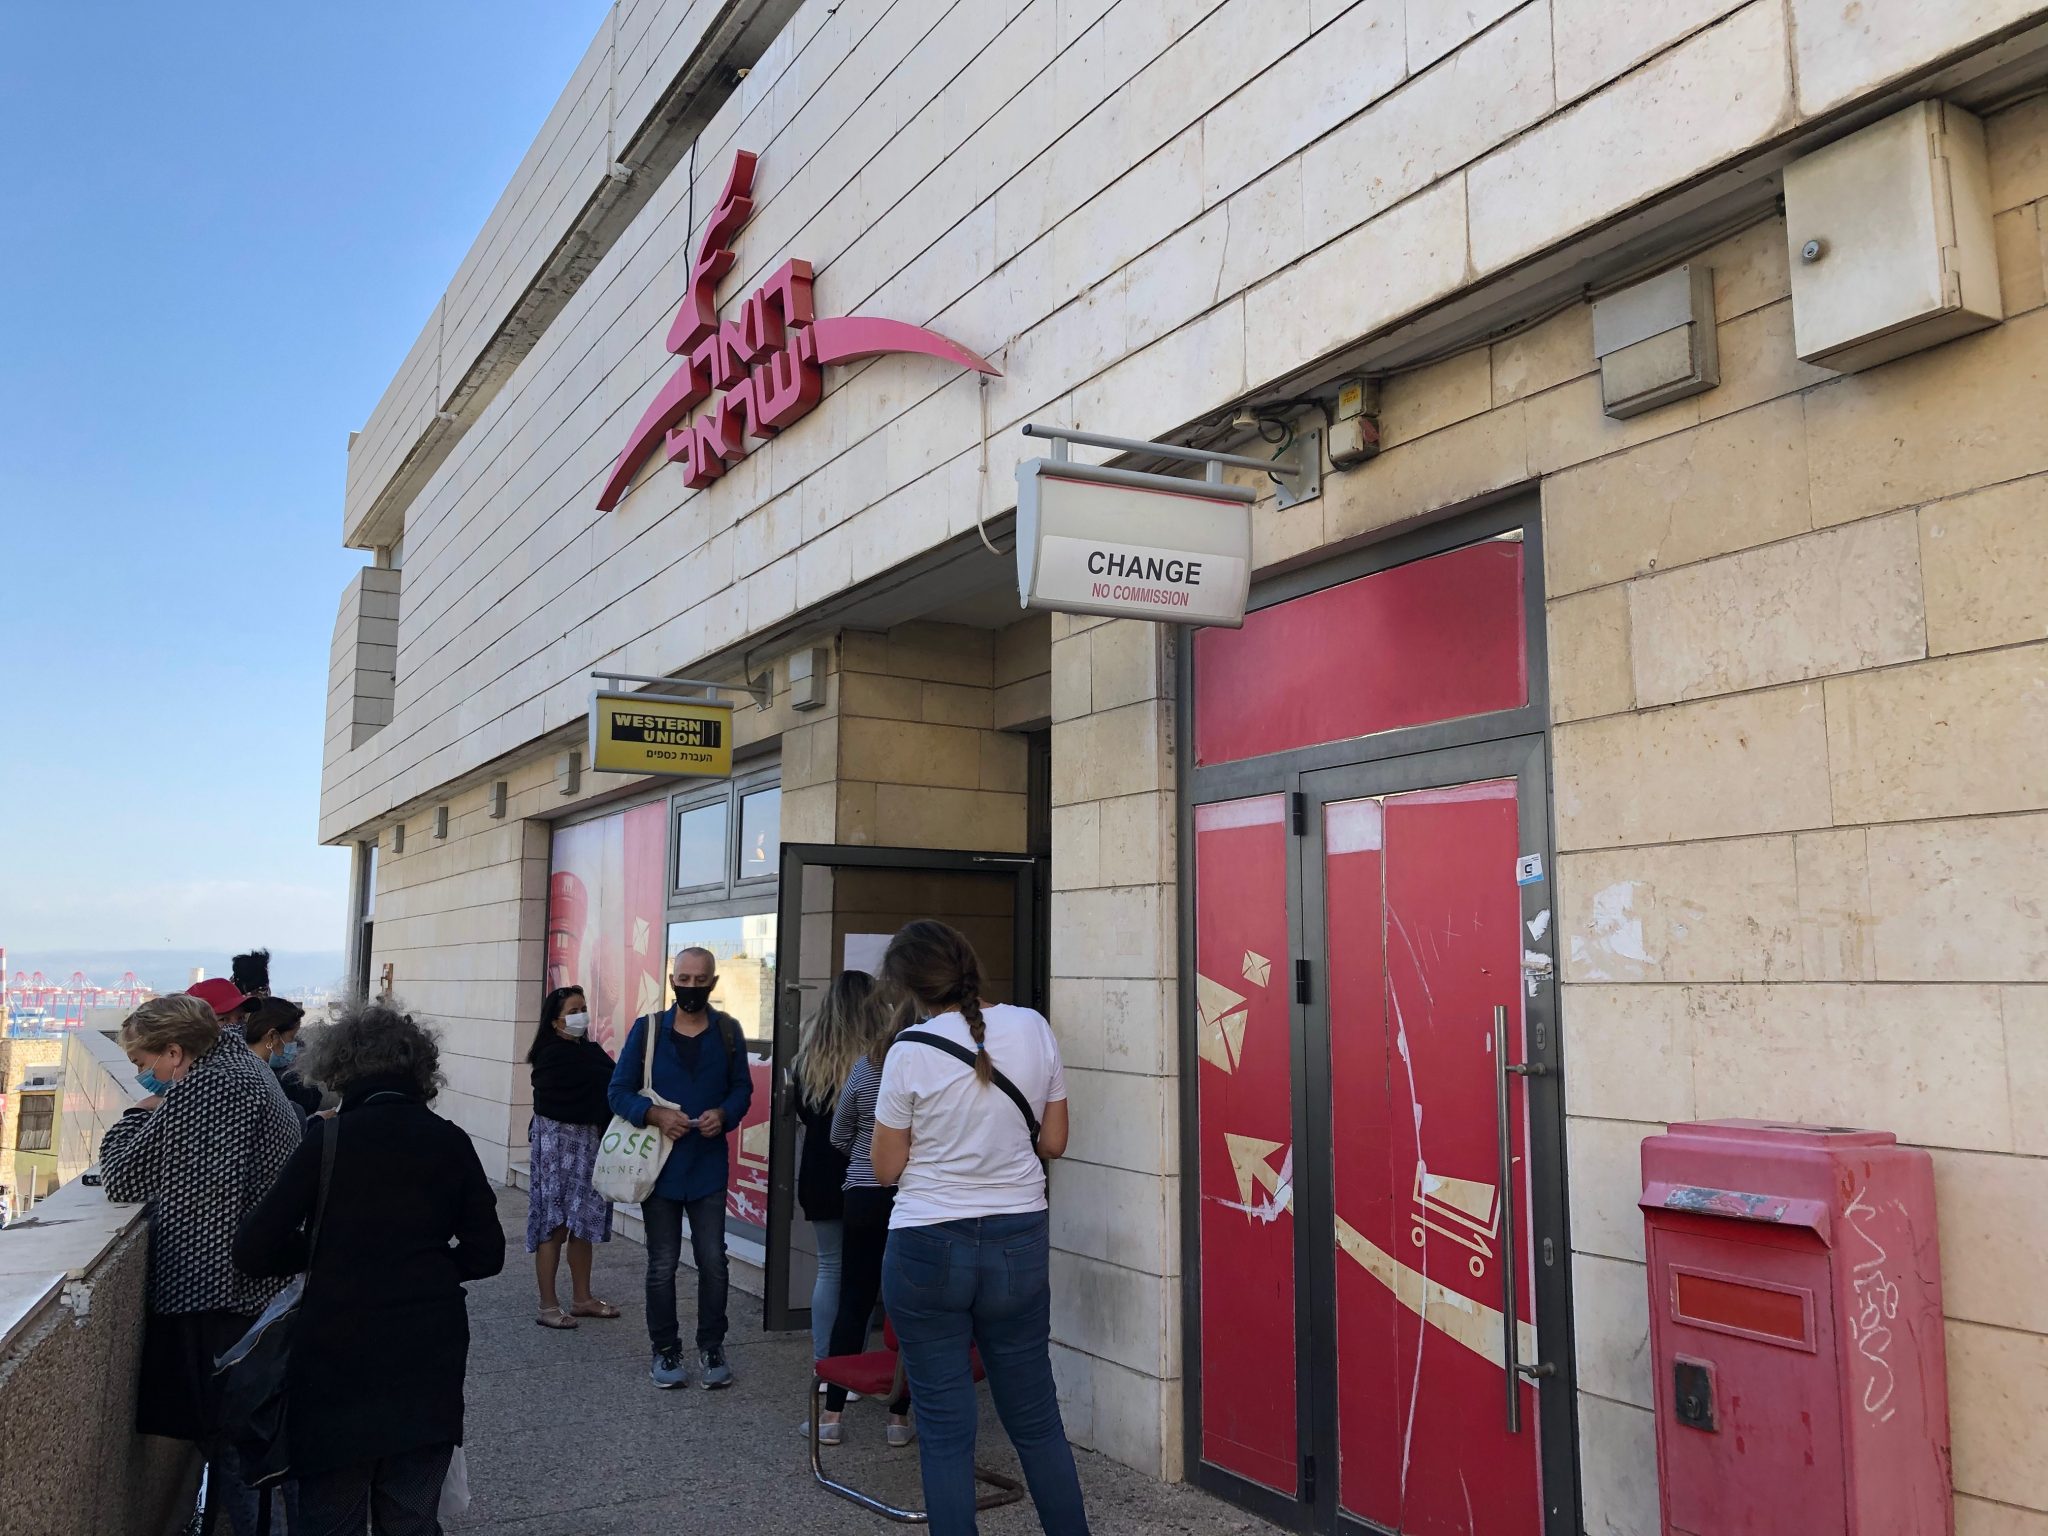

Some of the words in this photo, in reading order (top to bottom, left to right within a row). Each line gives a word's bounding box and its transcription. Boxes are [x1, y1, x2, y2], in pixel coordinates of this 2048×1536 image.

[693, 258, 814, 390] דואר
[666, 324, 821, 489] ישראל
[1087, 551, 1202, 585] CHANGE
[1092, 582, 1110, 599] NO
[1113, 585, 1189, 606] COMMISSION
[615, 714, 700, 731] WESTERN
[643, 730, 700, 745] UNION
[646, 750, 677, 760] כספים
[680, 752, 713, 763] העברת
[603, 1132, 656, 1160] OSE
